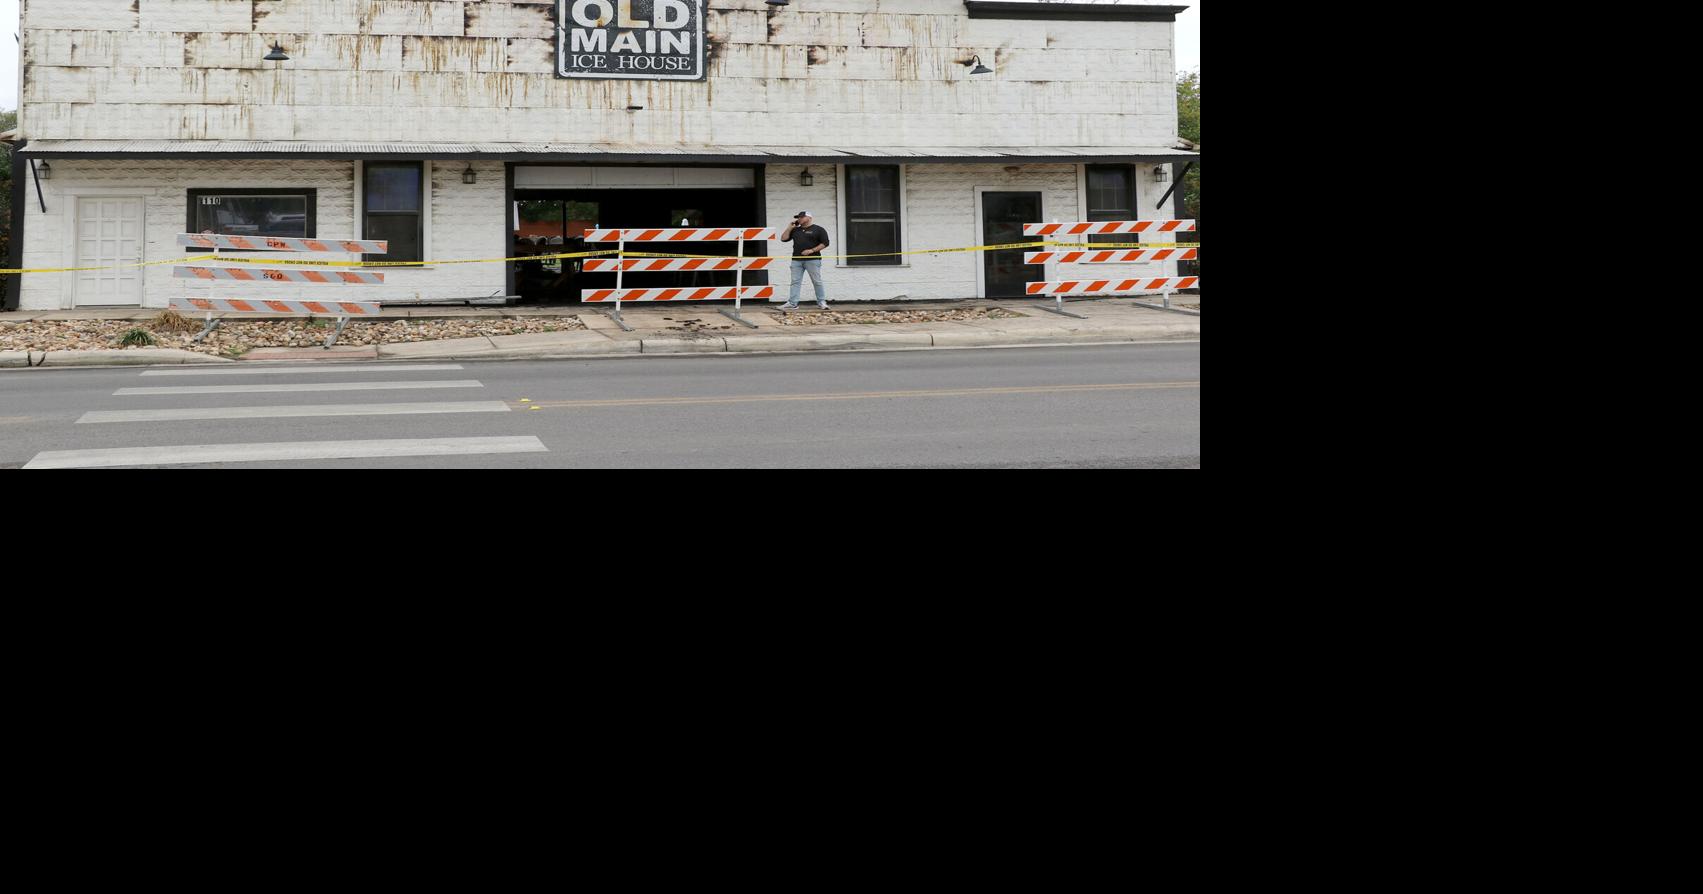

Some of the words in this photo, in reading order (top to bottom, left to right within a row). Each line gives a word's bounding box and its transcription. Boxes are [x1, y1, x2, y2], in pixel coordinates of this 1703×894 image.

[571, 0, 690, 29] OLD
[571, 28, 690, 54] MAIN
[571, 54, 607, 69] ICE
[618, 55, 691, 70] HOUSE
